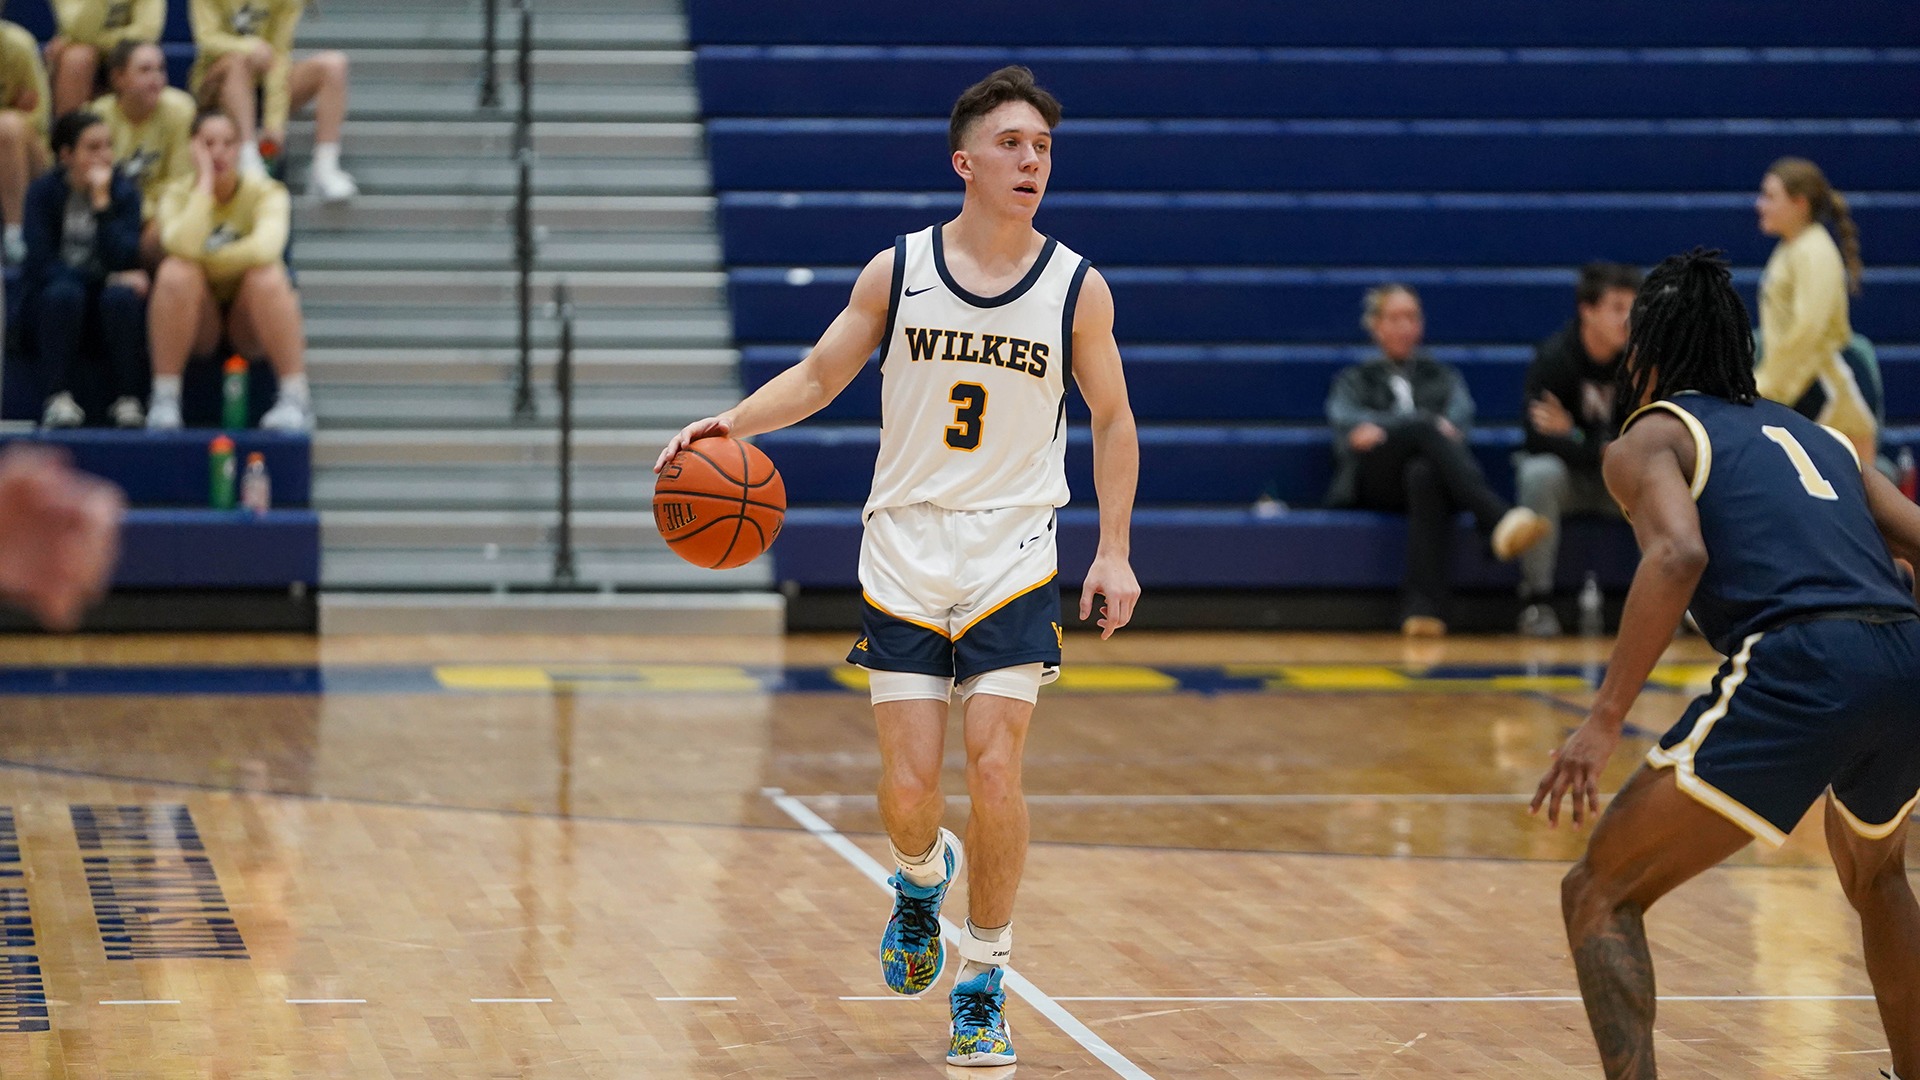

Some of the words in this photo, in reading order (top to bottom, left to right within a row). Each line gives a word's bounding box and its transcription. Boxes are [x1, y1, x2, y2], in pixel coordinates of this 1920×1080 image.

[905, 327, 1049, 379] WILKES
[943, 380, 988, 452] 3
[1761, 424, 1839, 501] 1
[663, 502, 697, 531] THE
